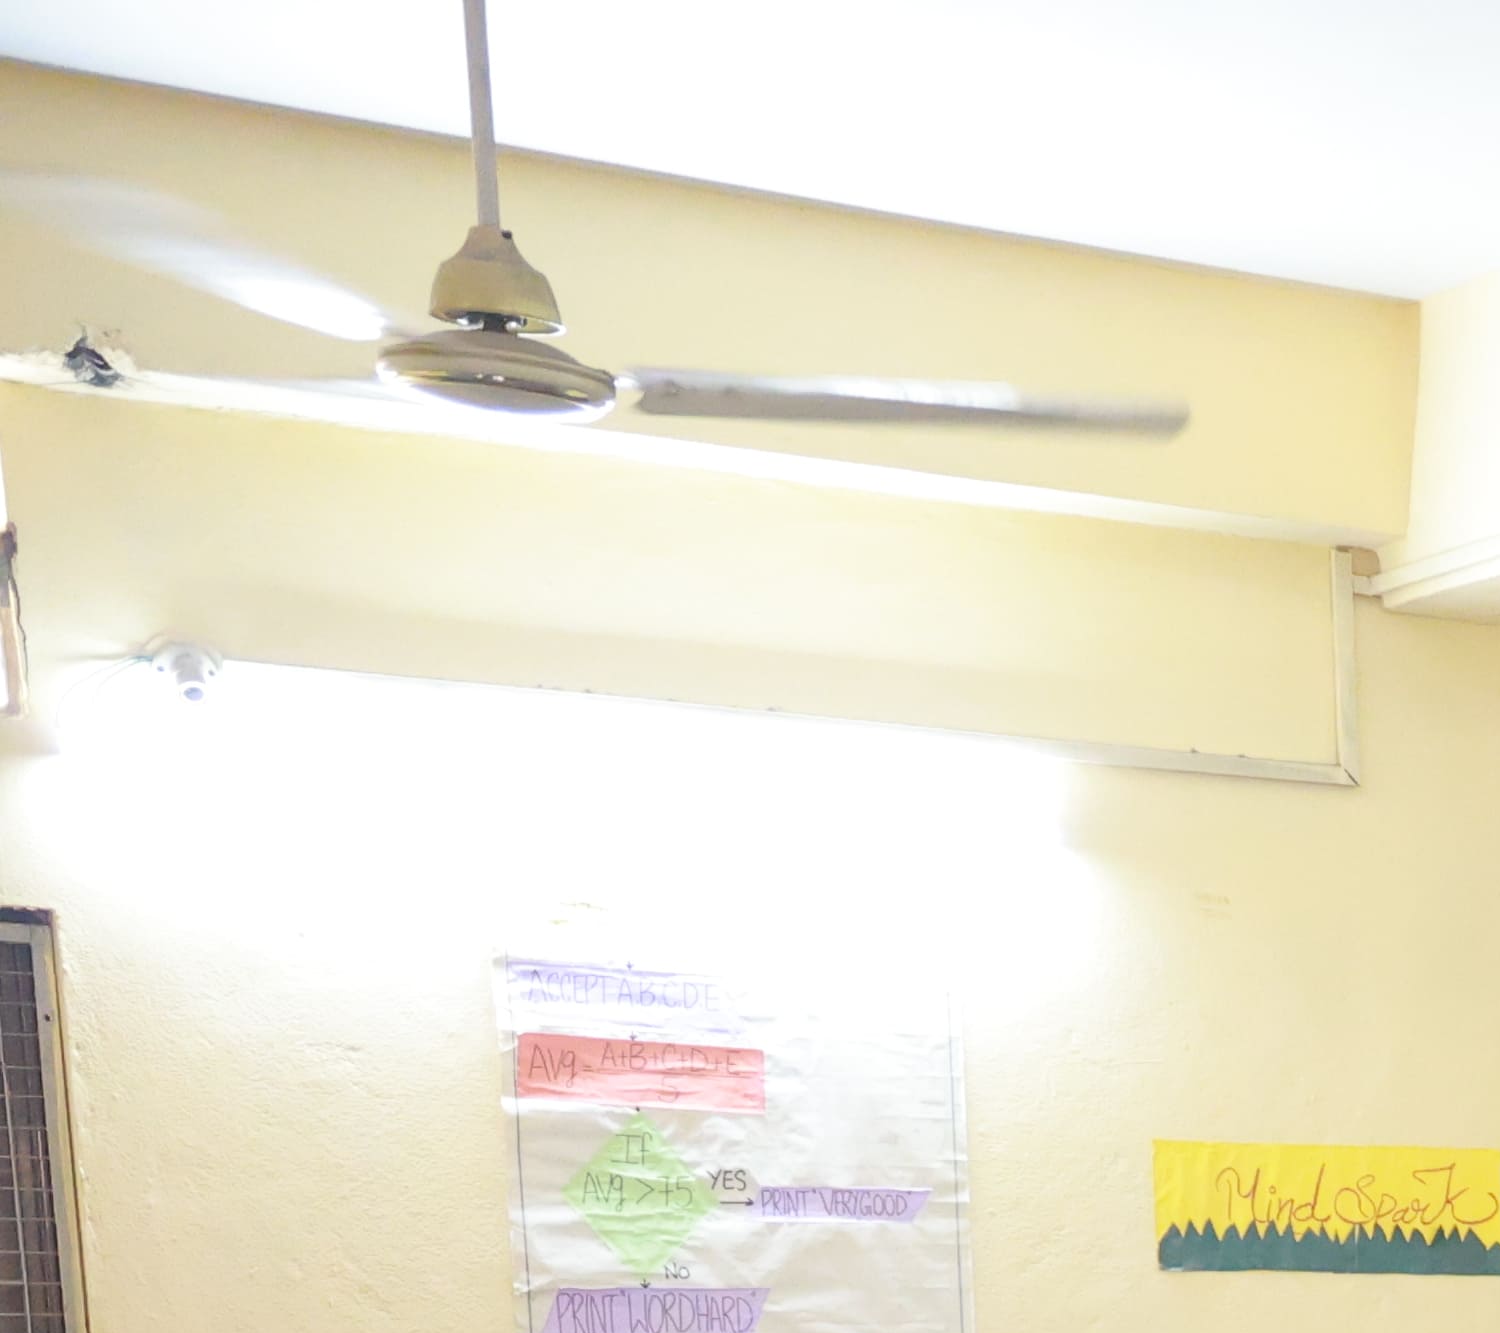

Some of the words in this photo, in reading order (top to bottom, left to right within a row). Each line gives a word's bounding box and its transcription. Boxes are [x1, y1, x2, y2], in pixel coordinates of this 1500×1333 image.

[527, 969, 608, 1004] ACCEPT
[611, 1131, 652, 1165] If
[706, 1169, 747, 1192] YES
[1215, 1163, 1332, 1226] Mind
[1334, 1162, 1500, 1227] Spark
[759, 1189, 810, 1217] PRINT
